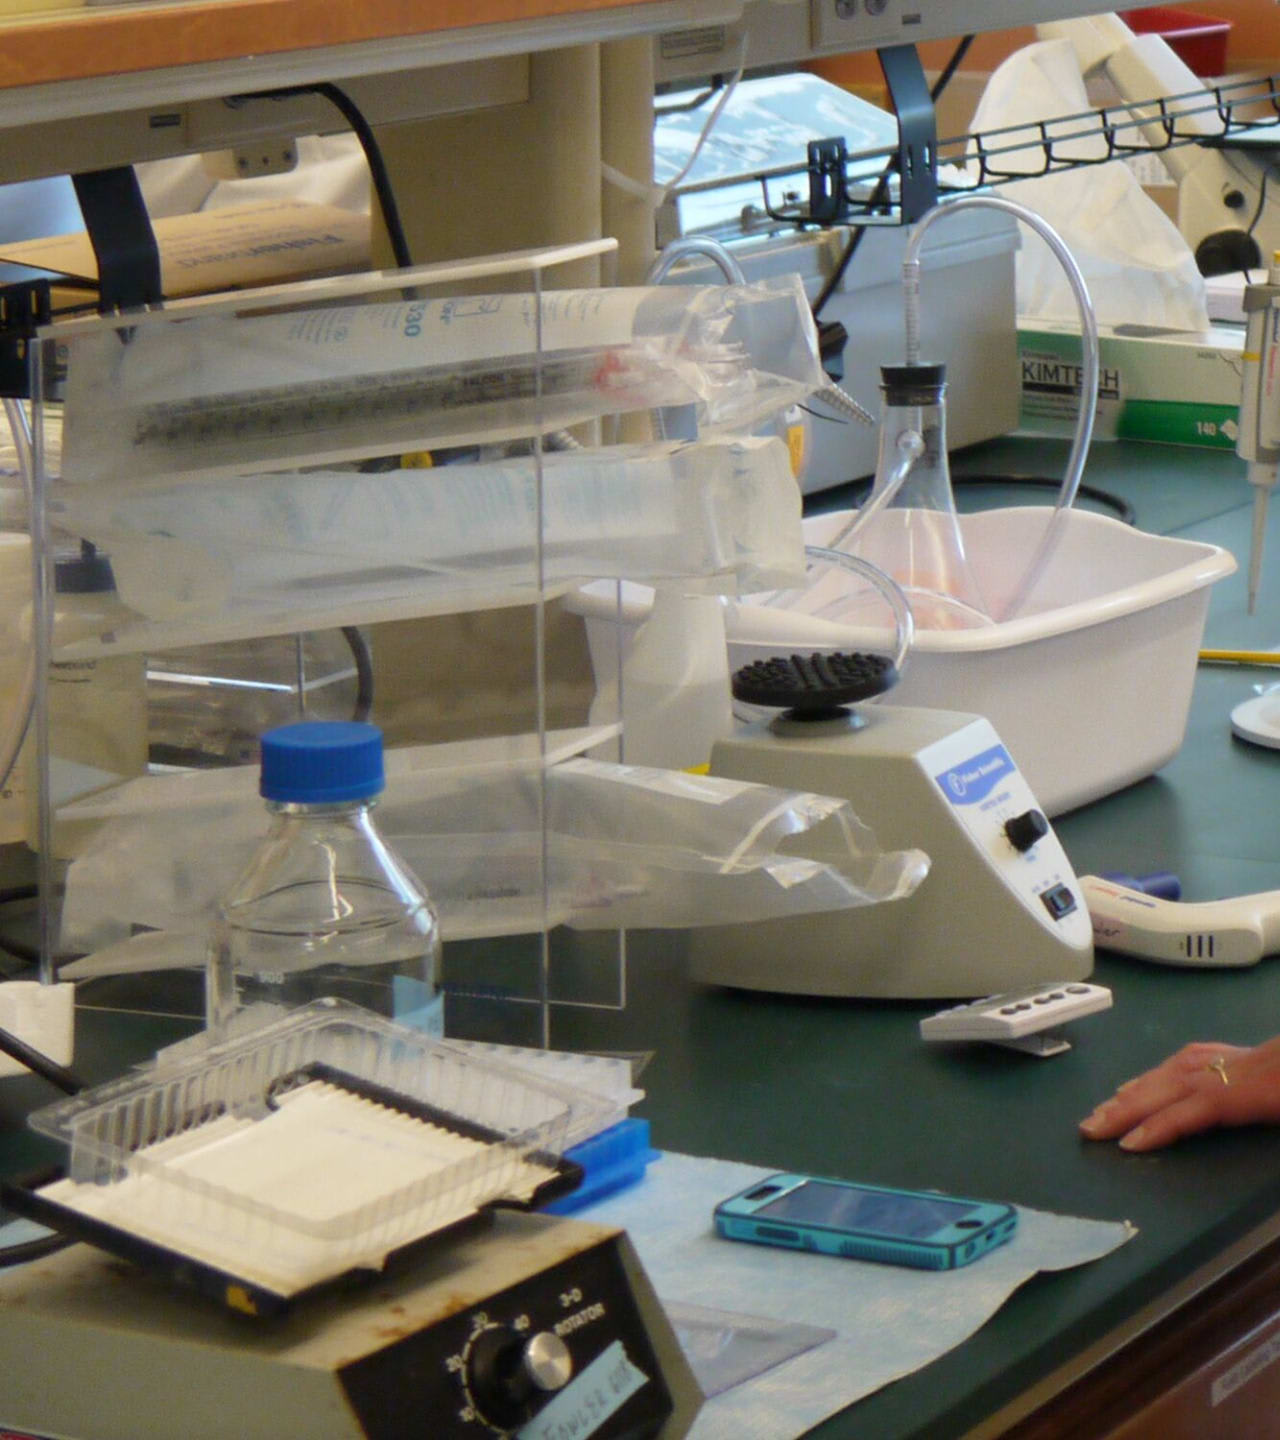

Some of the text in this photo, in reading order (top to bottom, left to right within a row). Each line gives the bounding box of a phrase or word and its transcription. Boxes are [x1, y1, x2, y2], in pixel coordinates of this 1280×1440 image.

[1021, 360, 1120, 389] KIMTEH
[560, 1287, 583, 1308] 3-D
[554, 1303, 605, 1337] ROTATOR
